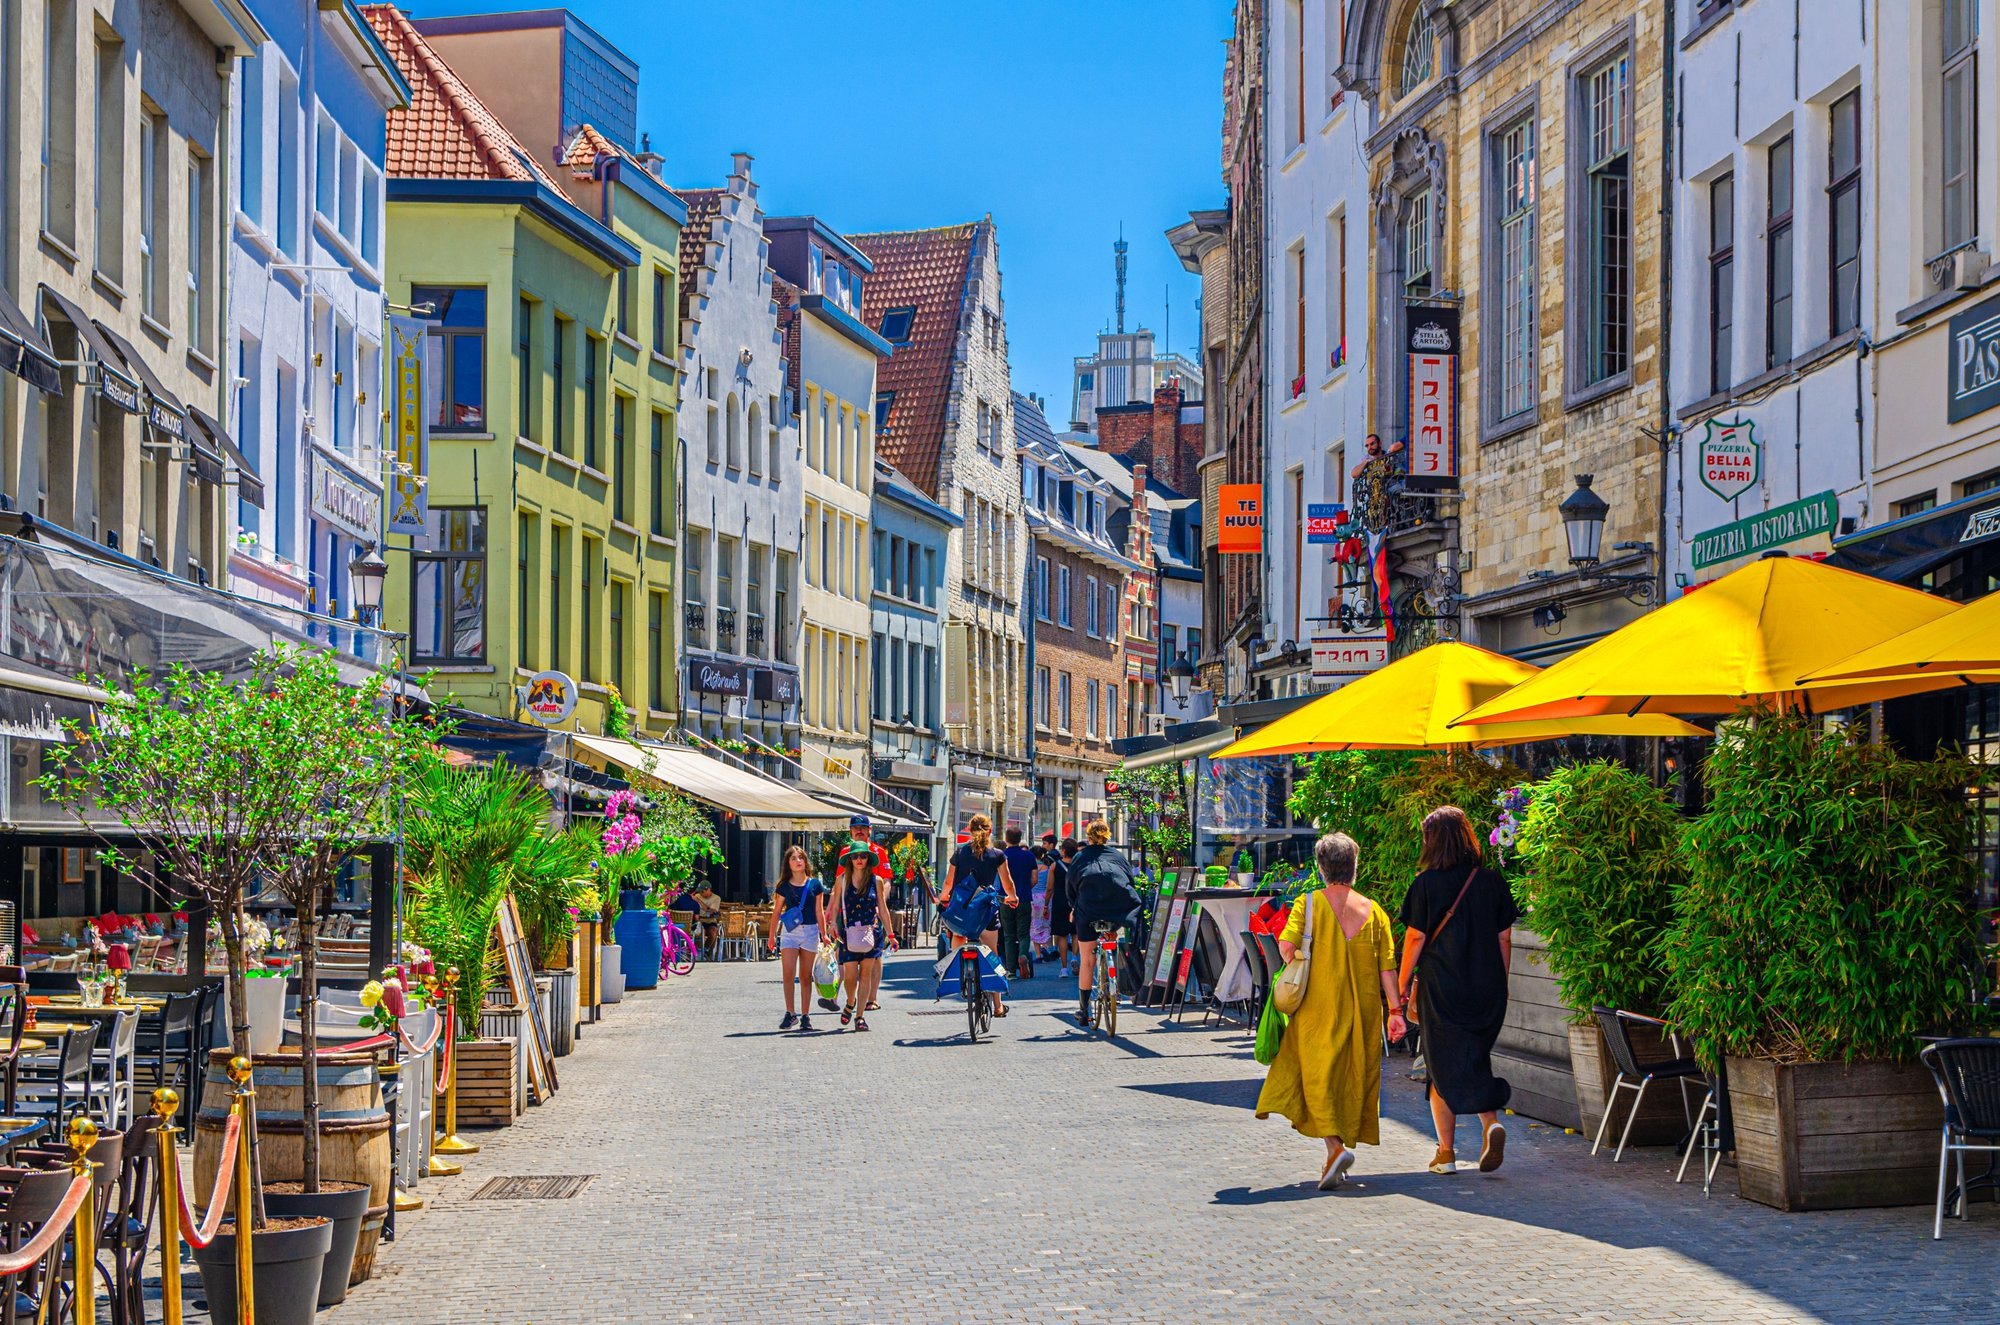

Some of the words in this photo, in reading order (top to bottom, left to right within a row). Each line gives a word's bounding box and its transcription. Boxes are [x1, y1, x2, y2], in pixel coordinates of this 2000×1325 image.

[104, 374, 136, 410] Restaurant
[404, 357, 414, 416] MEAT
[1422, 358, 1442, 445] TRAM
[406, 420, 414, 432] &
[1708, 445, 1751, 453] PIZZERIA
[1424, 452, 1438, 472] 3
[1707, 455, 1751, 466] BELLA
[1708, 470, 1750, 482] CAPRI
[1238, 500, 1256, 512] TE
[1694, 528, 1746, 565] PIZZERIA
[1751, 500, 1829, 548] RISTORANTE
[1314, 650, 1368, 663] TRAM
[1376, 650, 1386, 662] 3
